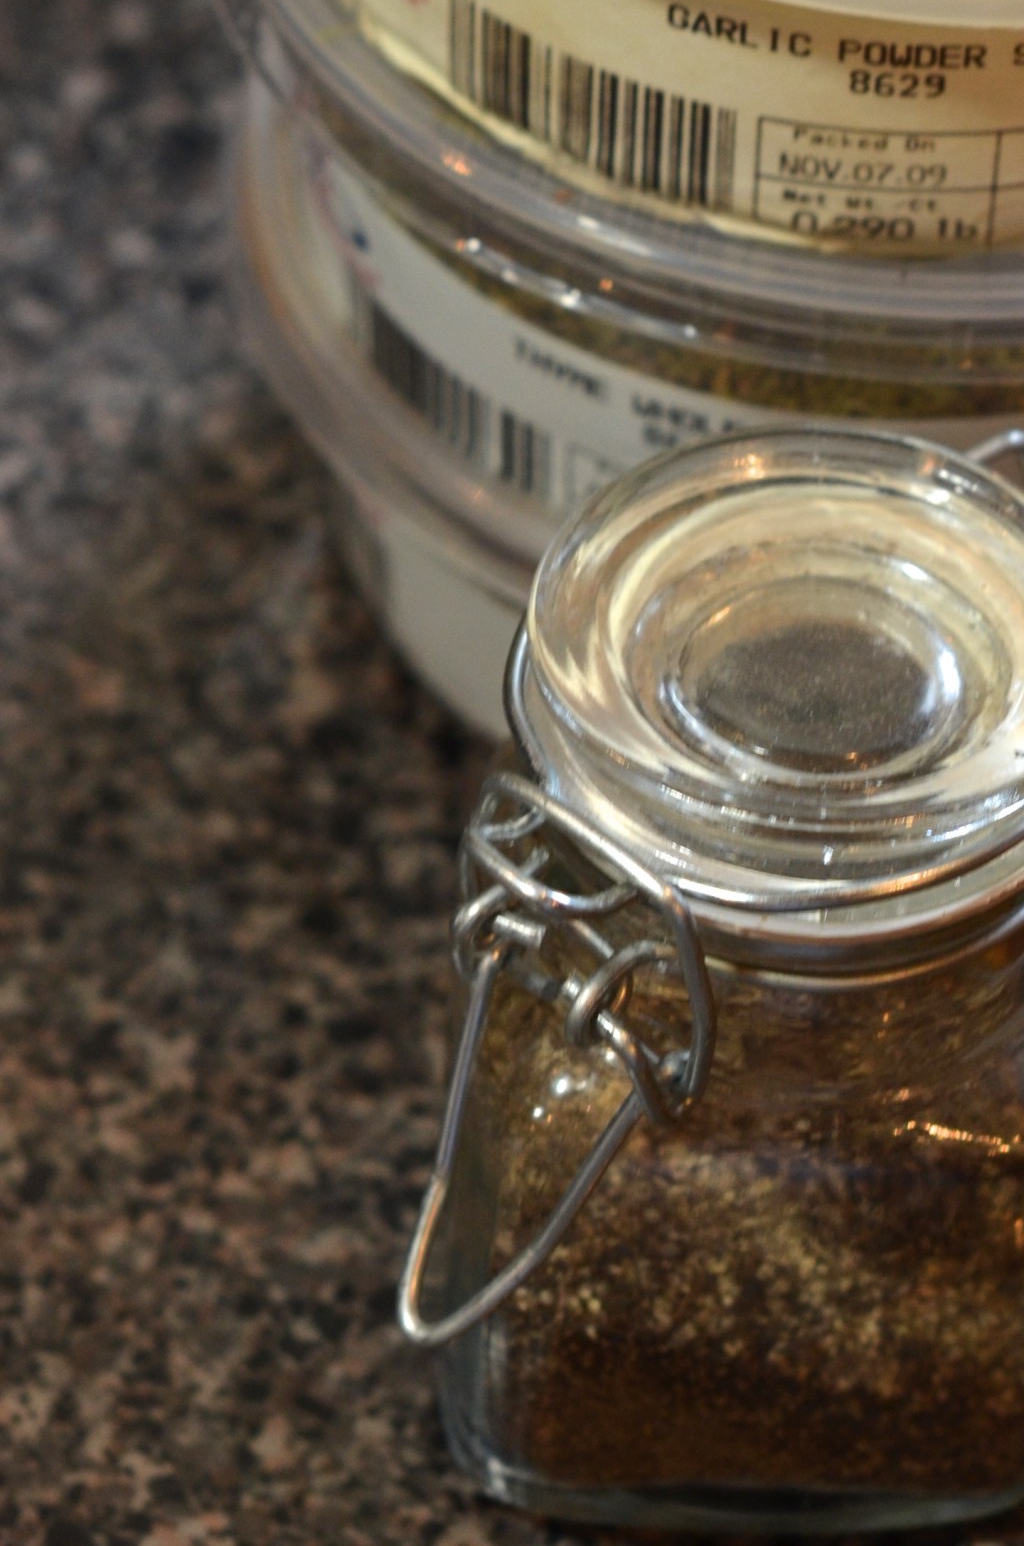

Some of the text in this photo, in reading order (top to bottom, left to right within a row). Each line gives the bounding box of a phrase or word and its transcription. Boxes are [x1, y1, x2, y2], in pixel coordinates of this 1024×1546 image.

[667, 1, 812, 58] GARLIC
[838, 37, 988, 70] POWDER
[849, 69, 947, 99] 8629
[794, 123, 936, 152] Packed On
